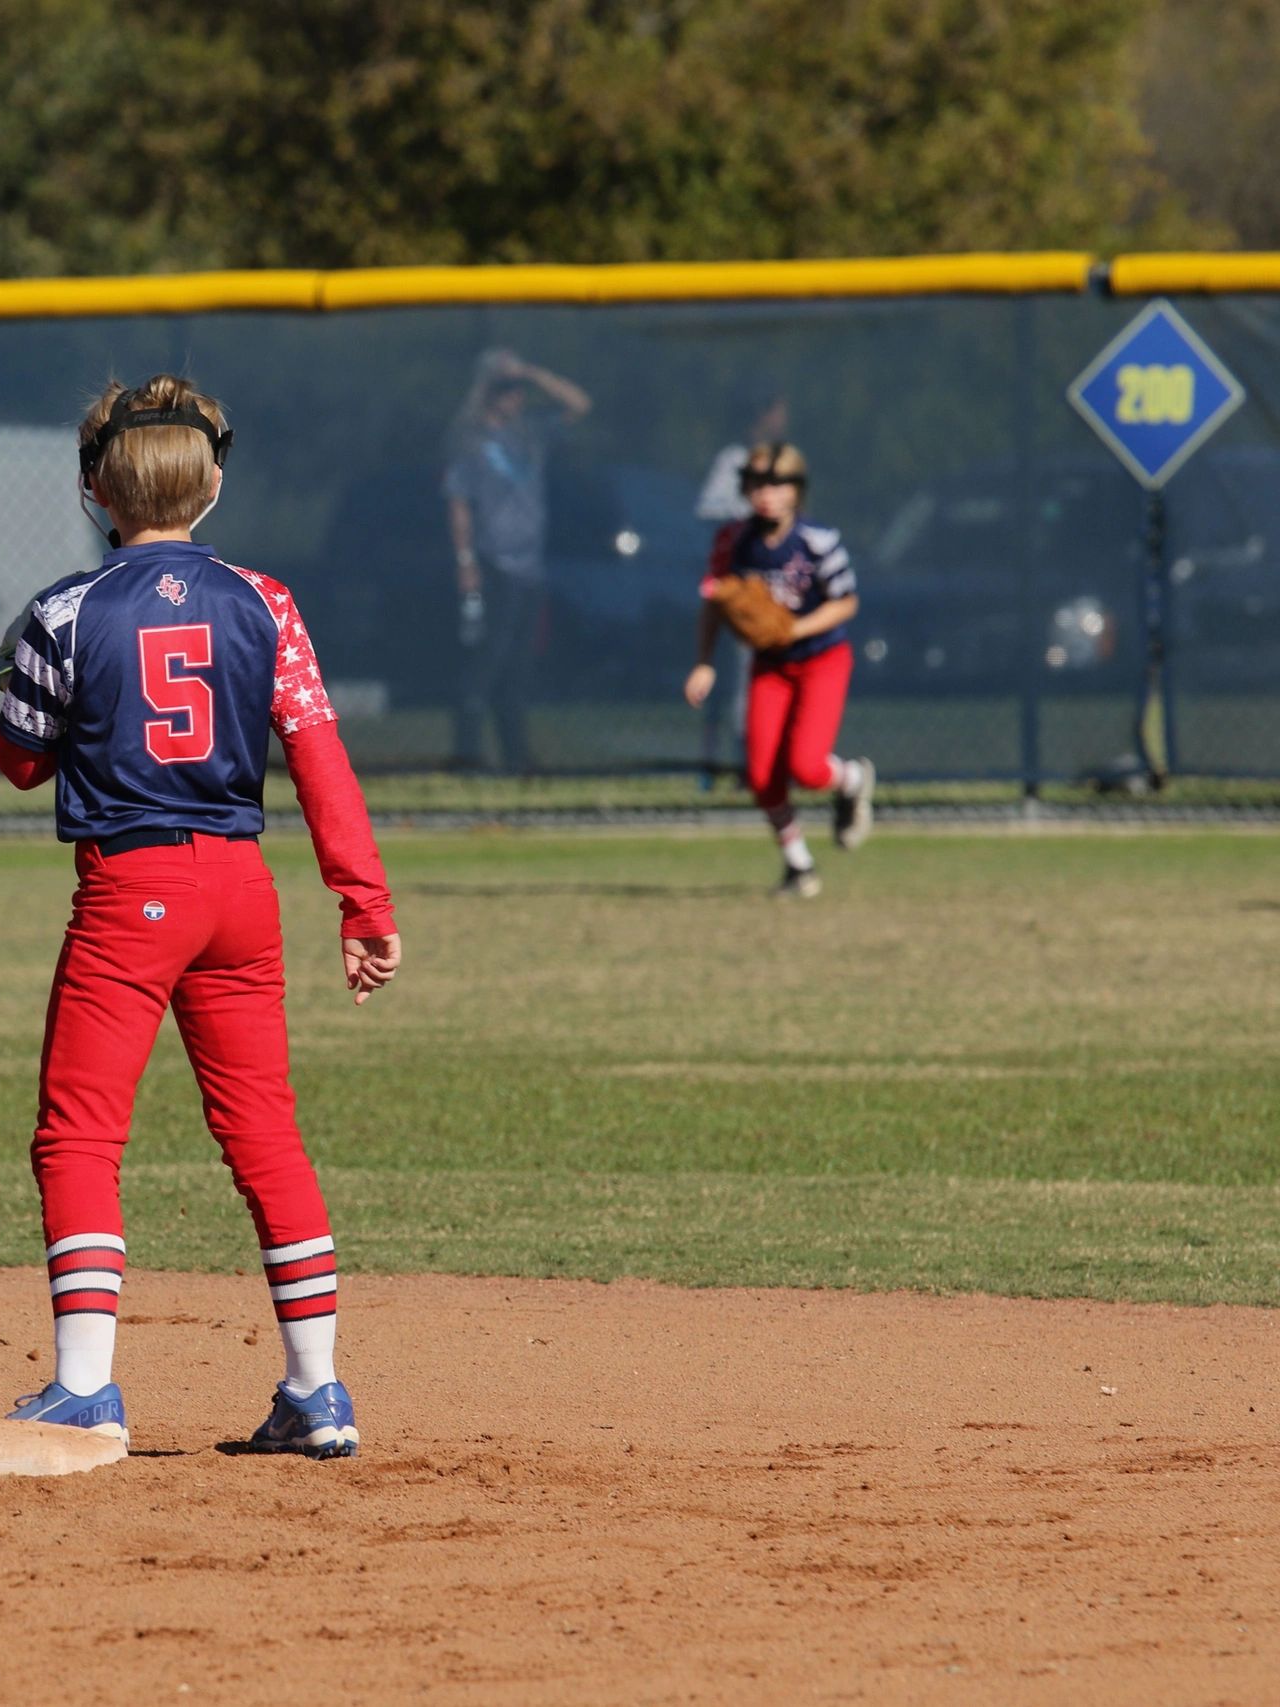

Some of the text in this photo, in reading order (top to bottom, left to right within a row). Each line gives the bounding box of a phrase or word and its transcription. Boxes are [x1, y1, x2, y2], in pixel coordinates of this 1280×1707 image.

[1117, 365, 1195, 424] 200
[138, 624, 214, 765] 5
[67, 1400, 120, 1428] POR
